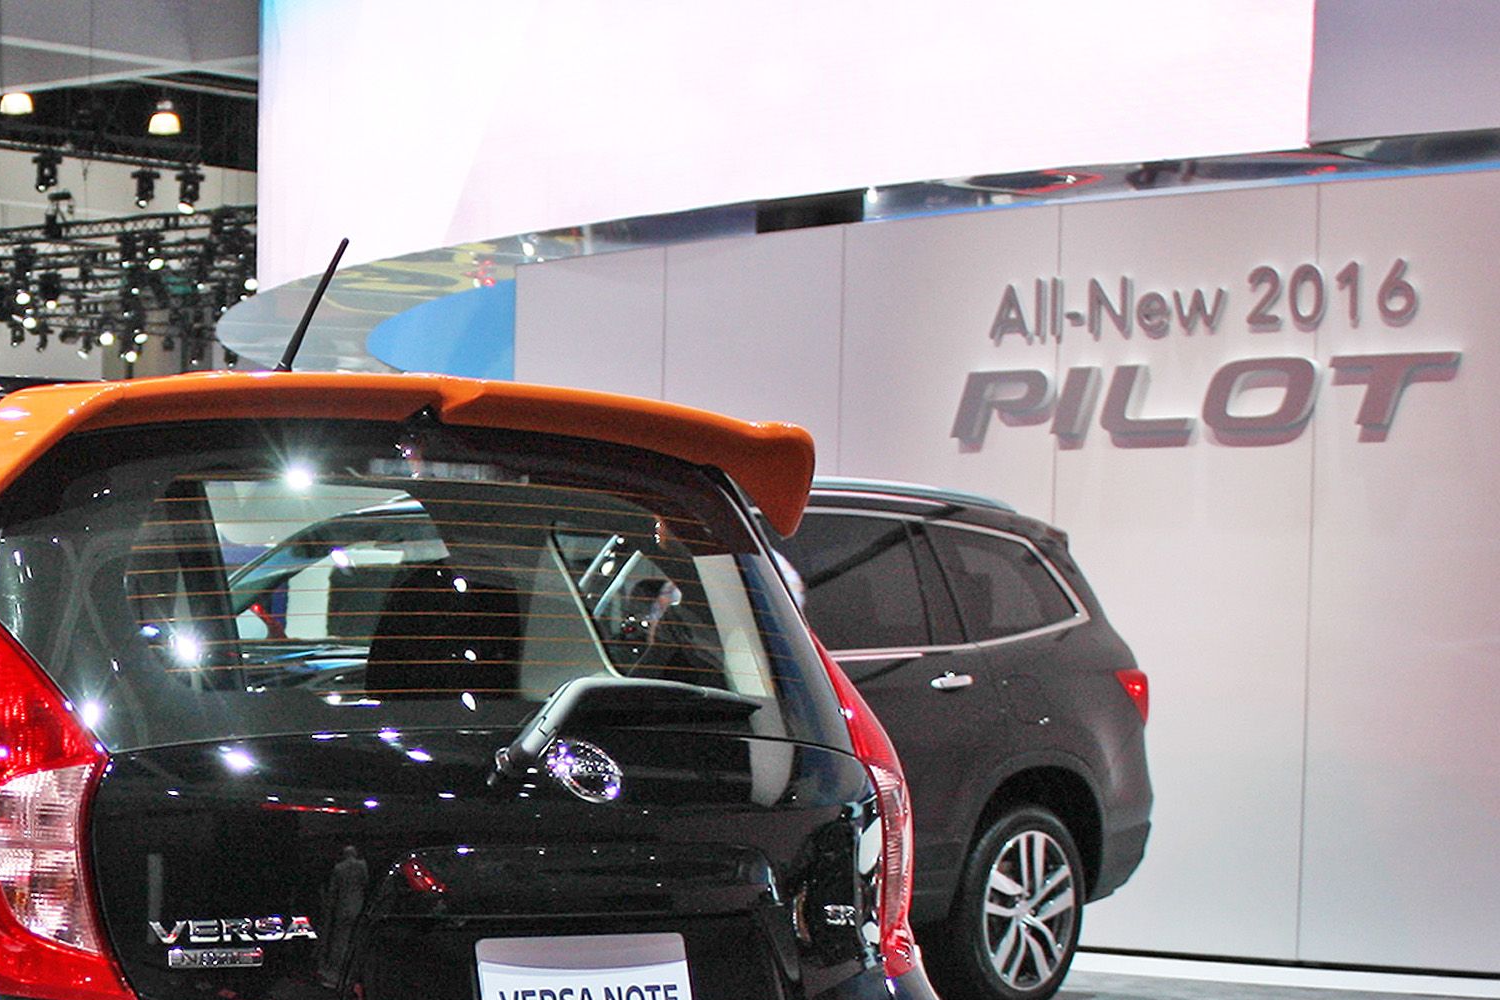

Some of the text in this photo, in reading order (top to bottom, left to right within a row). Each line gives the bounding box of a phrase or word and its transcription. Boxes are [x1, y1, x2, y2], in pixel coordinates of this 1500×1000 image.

[988, 258, 1419, 346] All-New 2016
[950, 351, 1463, 454] PILOT
[148, 914, 318, 944] VERSA
